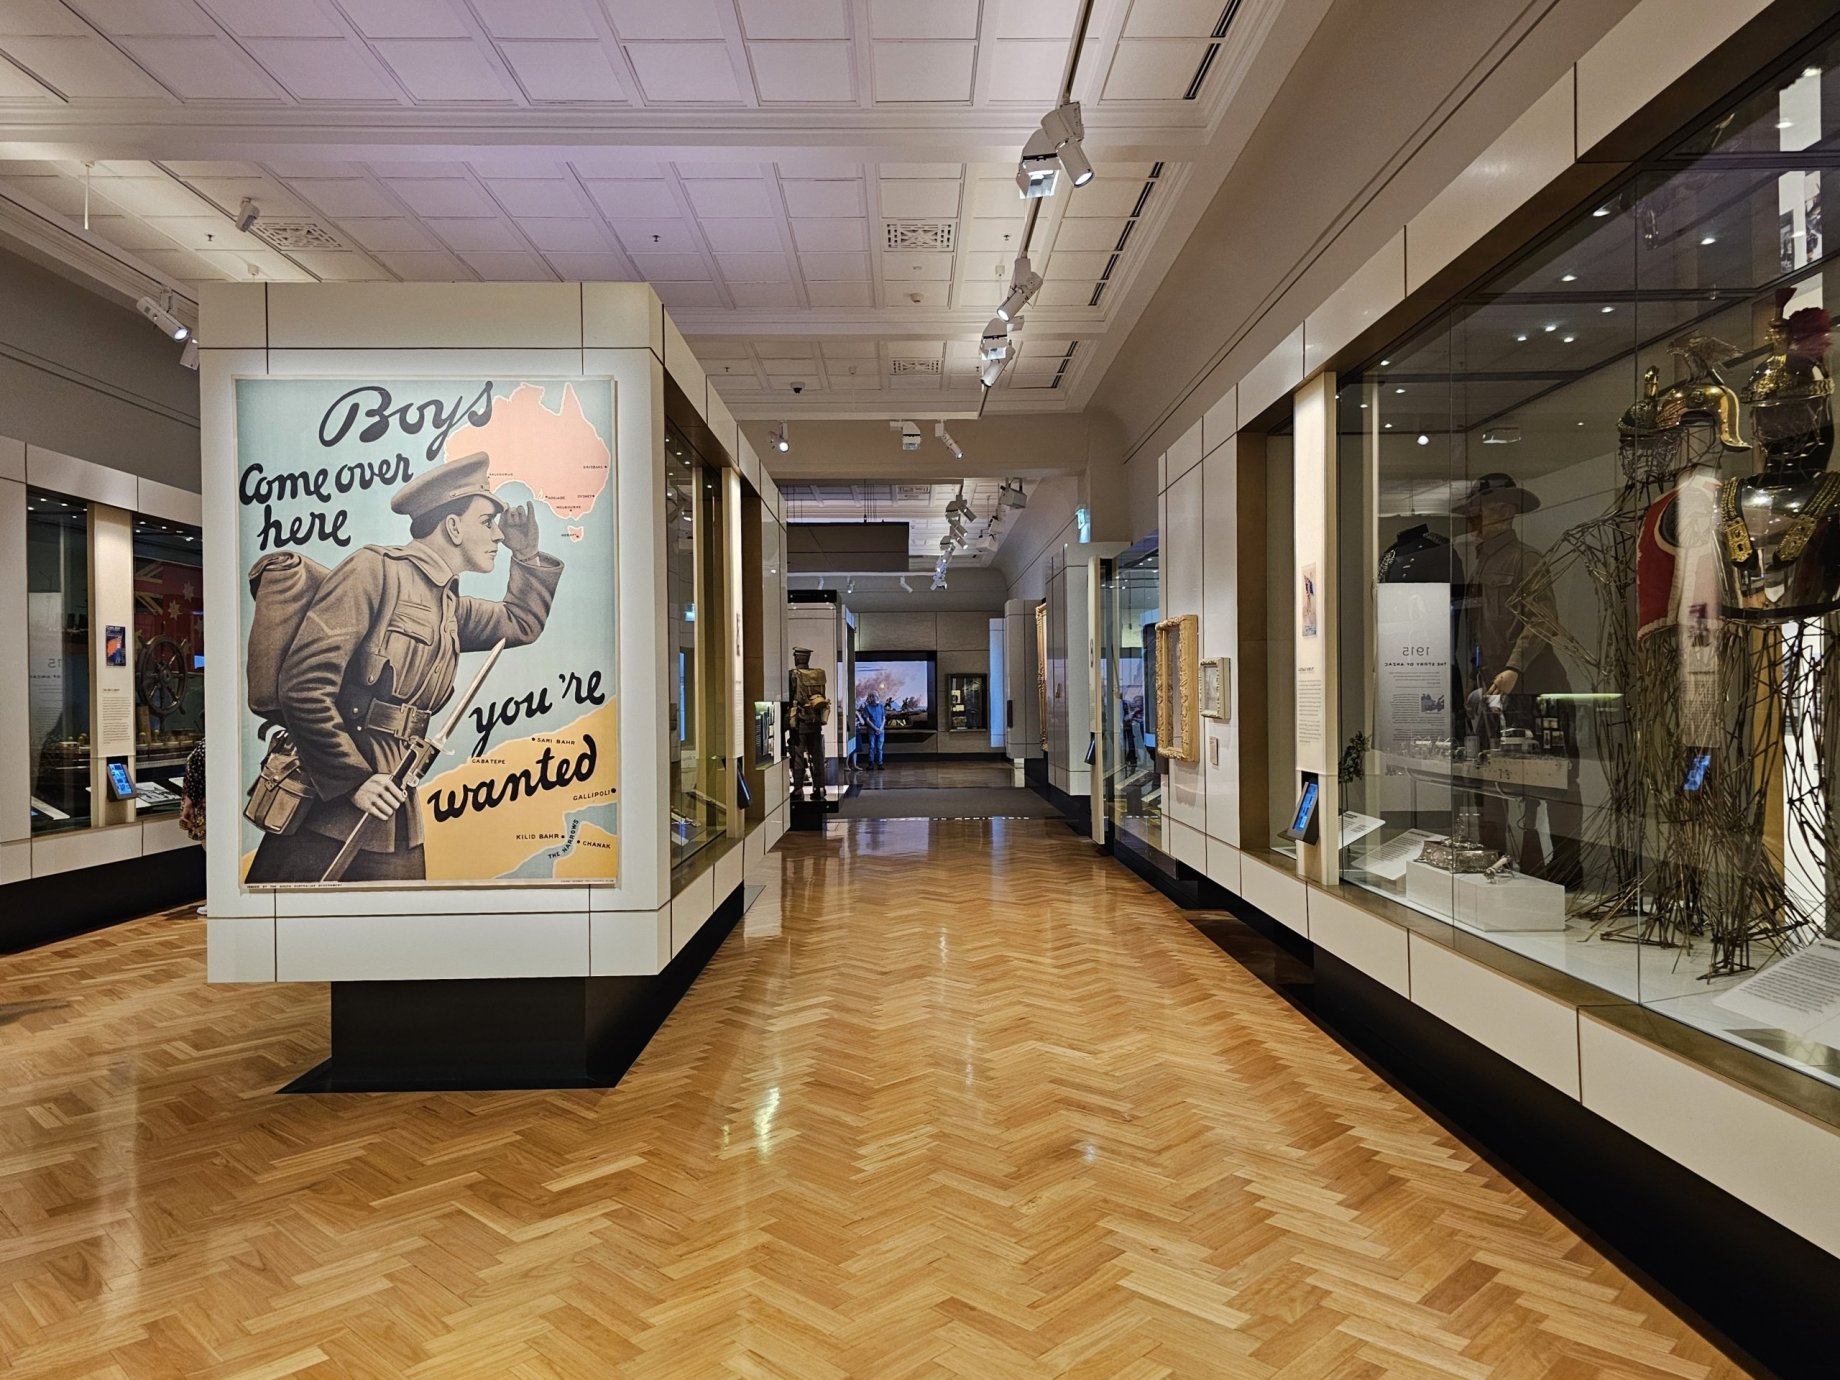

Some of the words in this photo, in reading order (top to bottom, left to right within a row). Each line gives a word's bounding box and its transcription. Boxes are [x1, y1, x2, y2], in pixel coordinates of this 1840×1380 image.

[318, 380, 494, 461] Boys
[239, 462, 332, 506] Come
[334, 453, 414, 495] over
[256, 504, 352, 551] here
[468, 670, 606, 758] you're
[427, 734, 598, 823] wanted
[572, 789, 611, 801] GALLIPOLI
[548, 851, 561, 860] THE
[561, 819, 579, 853] NARROWS
[582, 840, 611, 849] CHANAK
